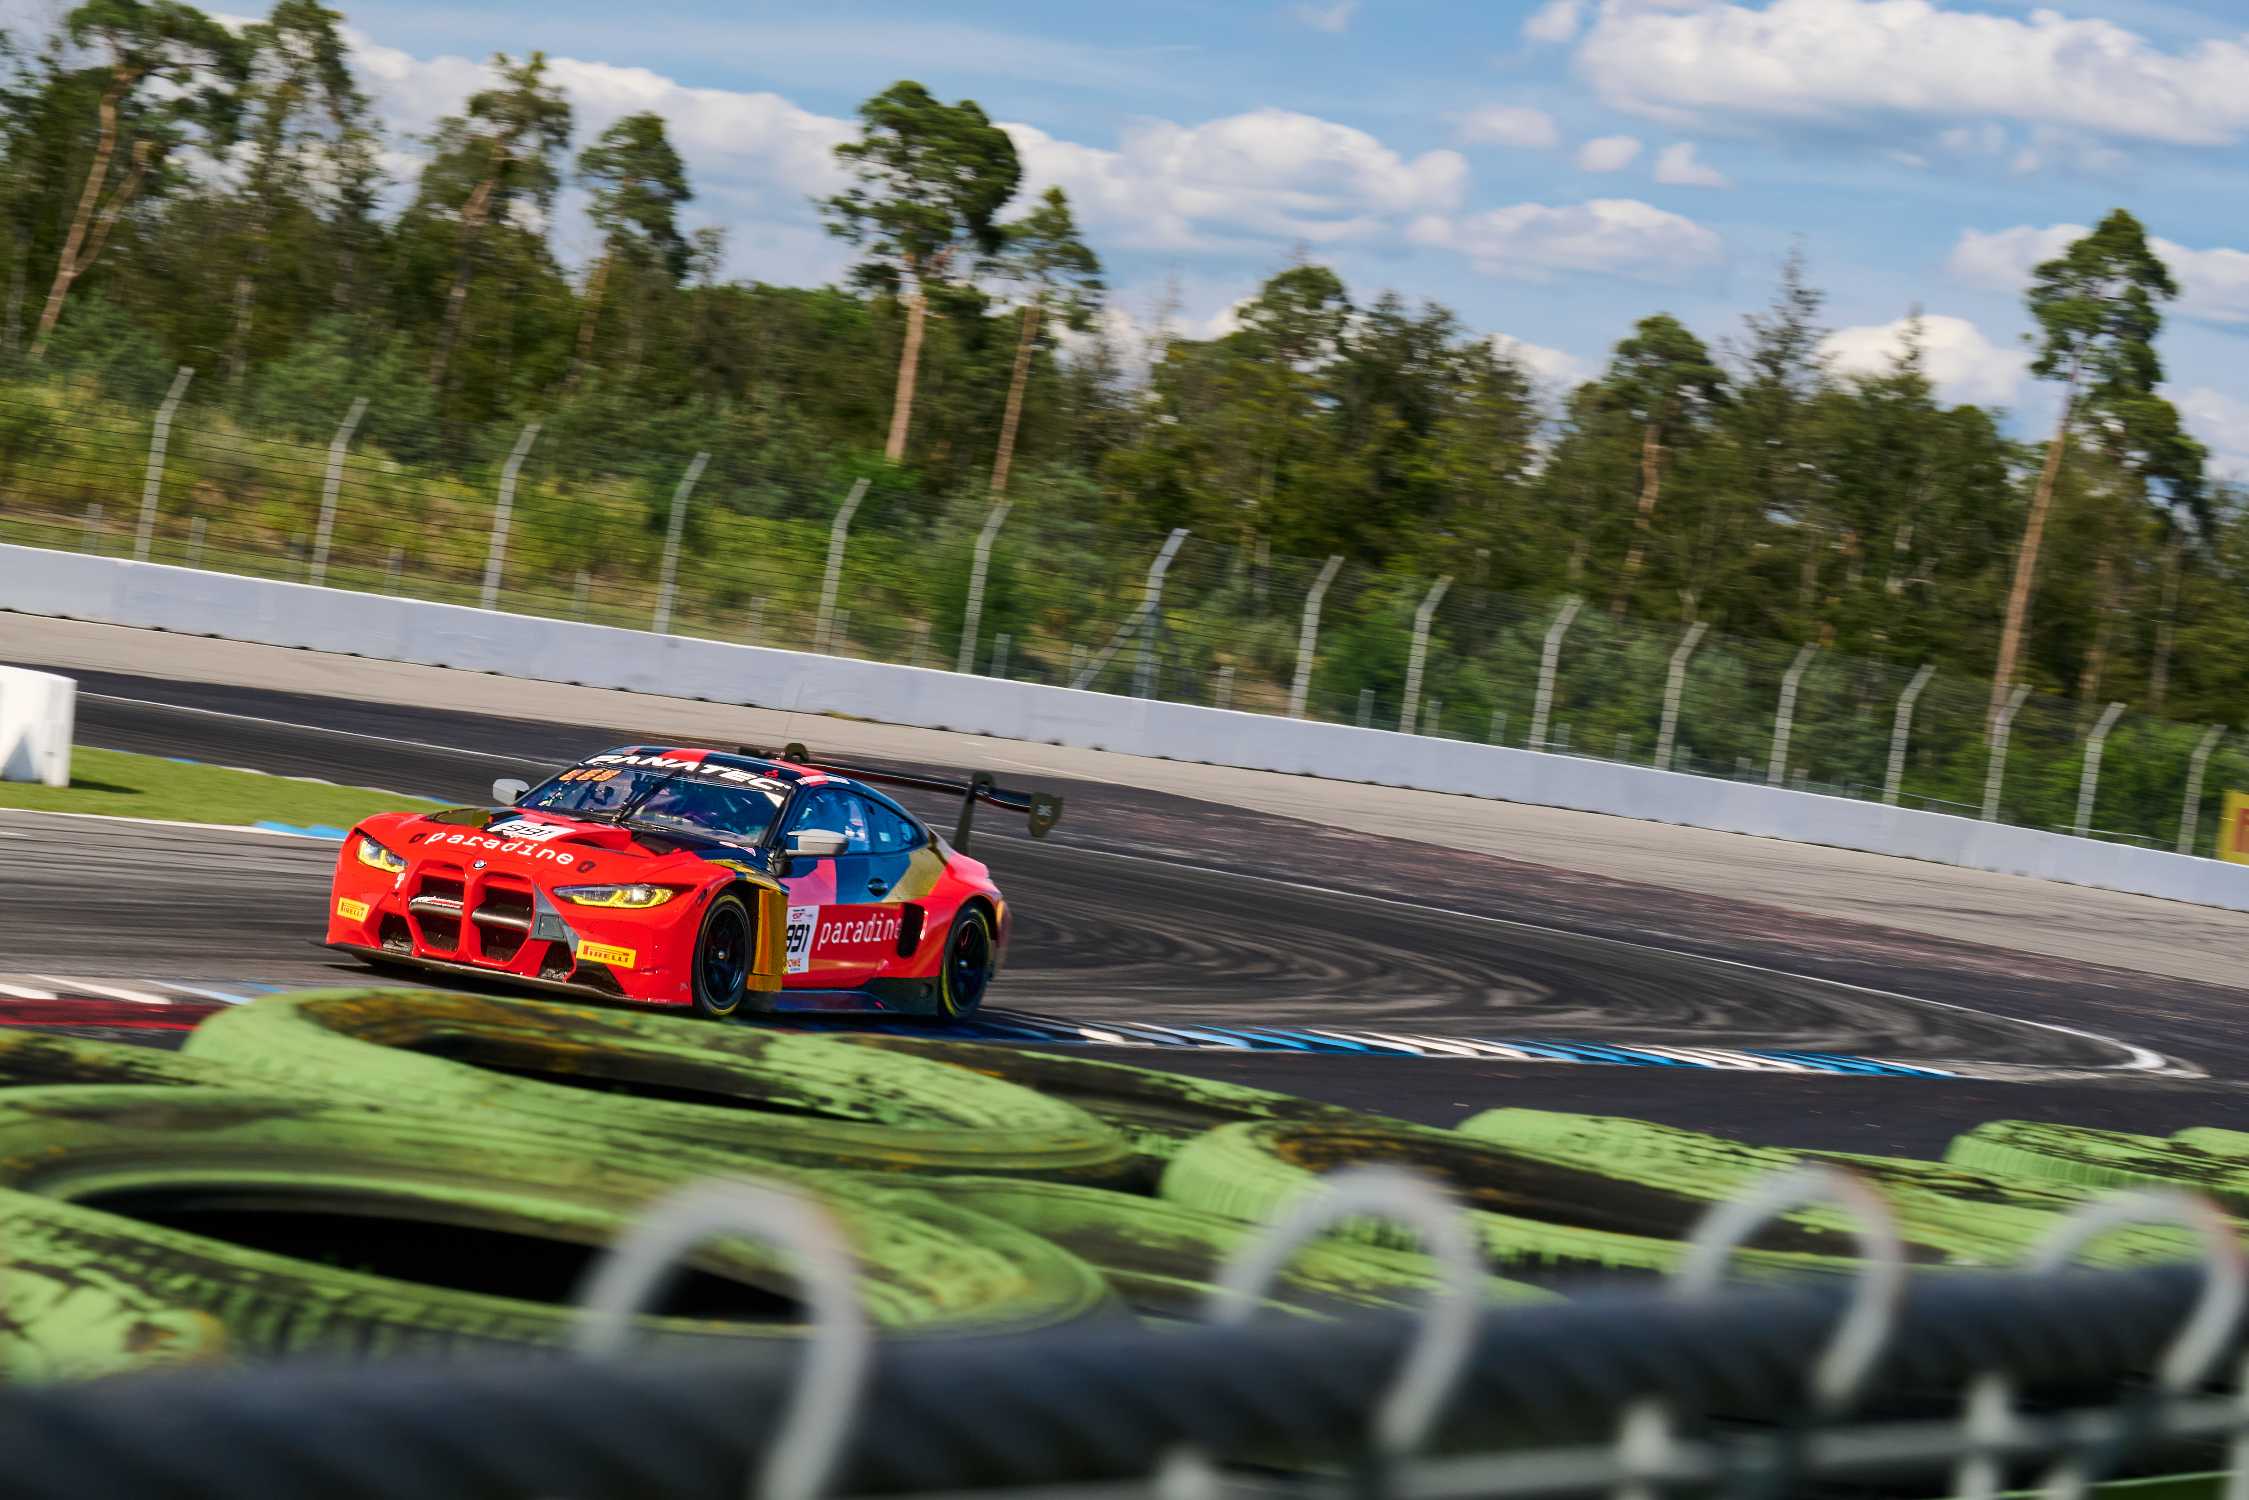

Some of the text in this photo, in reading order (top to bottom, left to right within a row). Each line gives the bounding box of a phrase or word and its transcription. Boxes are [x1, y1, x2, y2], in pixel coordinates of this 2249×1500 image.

[584, 755, 787, 790] FANATEC
[424, 832, 574, 864] paradine
[341, 903, 365, 918] PIRELLI
[786, 924, 810, 952] 991
[583, 945, 630, 963] PIRELLI
